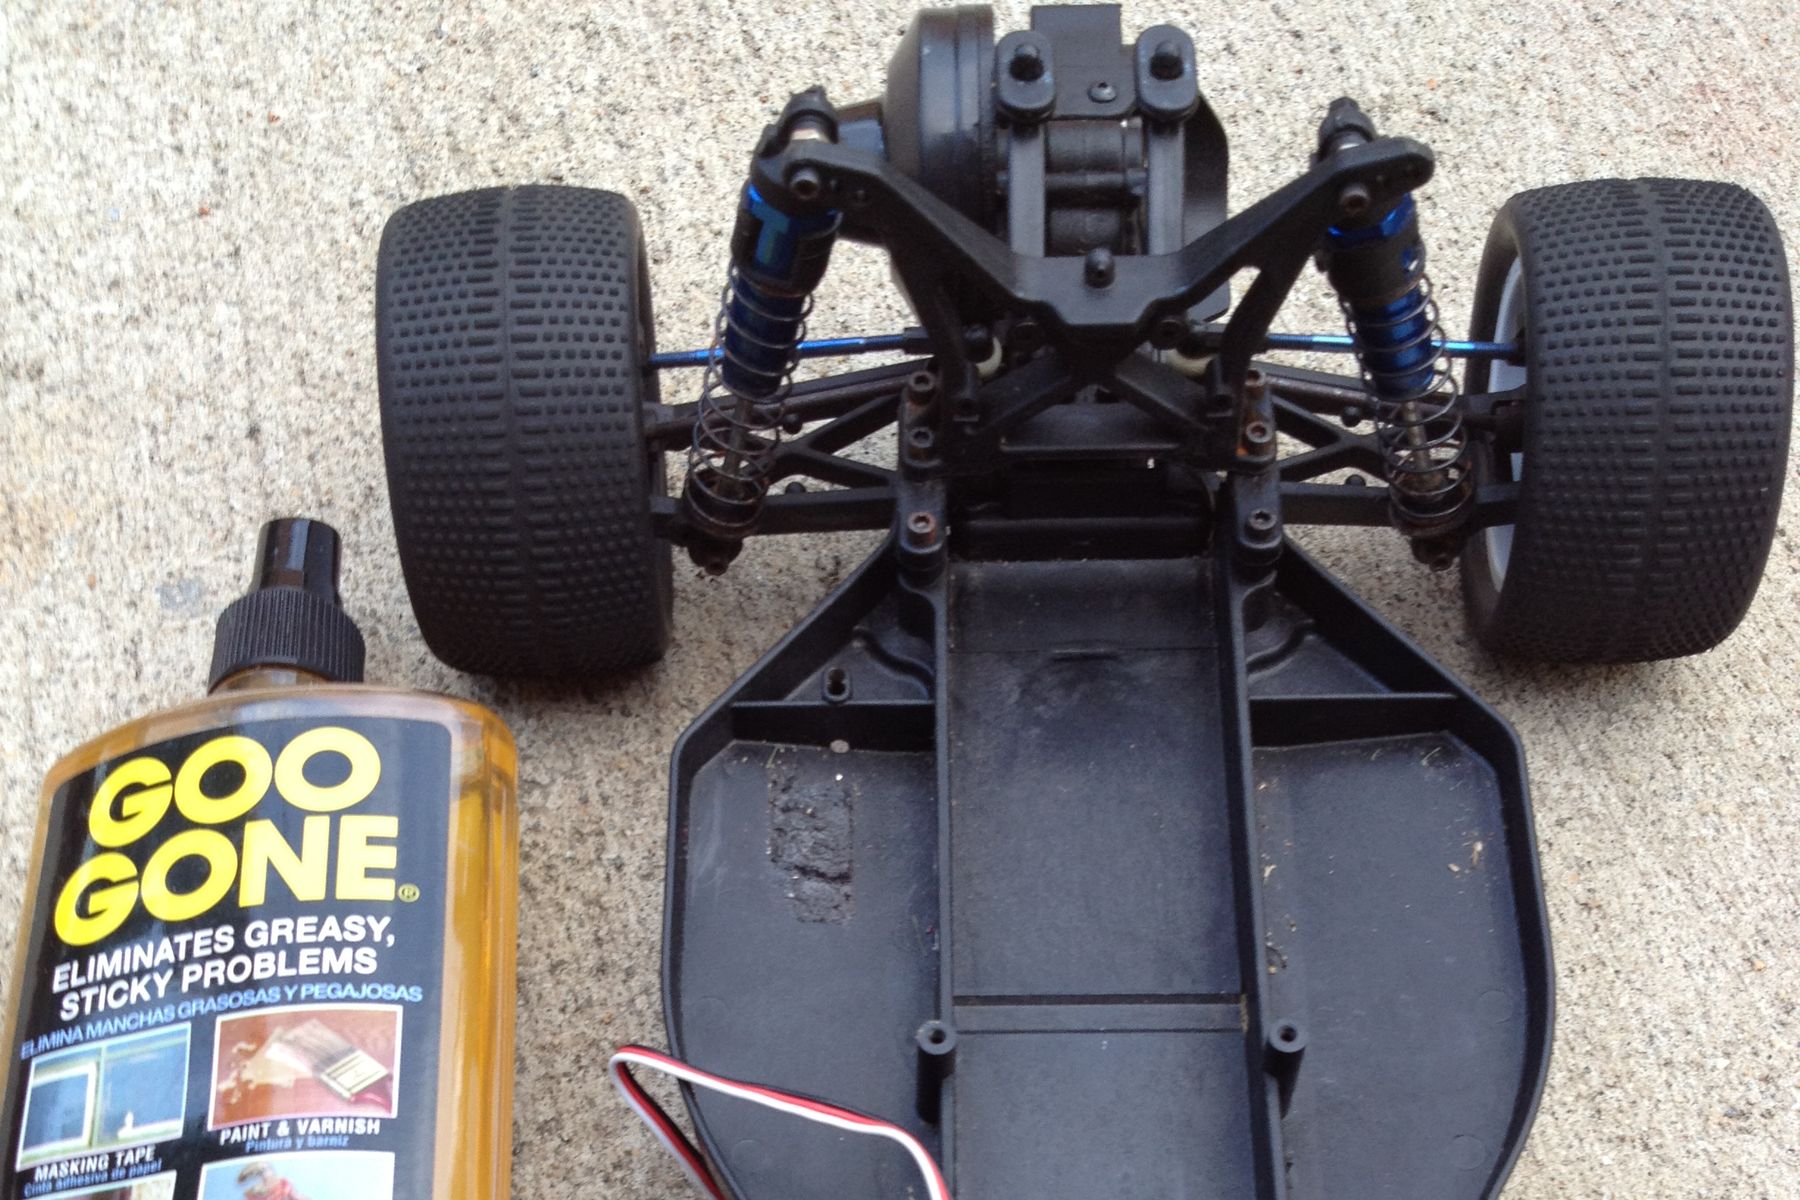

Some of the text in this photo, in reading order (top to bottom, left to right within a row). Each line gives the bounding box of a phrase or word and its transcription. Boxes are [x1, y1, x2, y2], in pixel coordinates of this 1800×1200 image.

[89, 726, 381, 848] GOO
[54, 815, 399, 946] GONE
[52, 915, 395, 994] ELIMINATES GREASY,
[60, 947, 378, 1022] STICKY PROBLEMS
[20, 982, 423, 1059] ELIMINA MANCHAS GRASOSAS Y PEGAJOSAS
[35, 1145, 156, 1182] MASKING TAPE
[220, 1118, 380, 1145] PAINT & VARNISH
